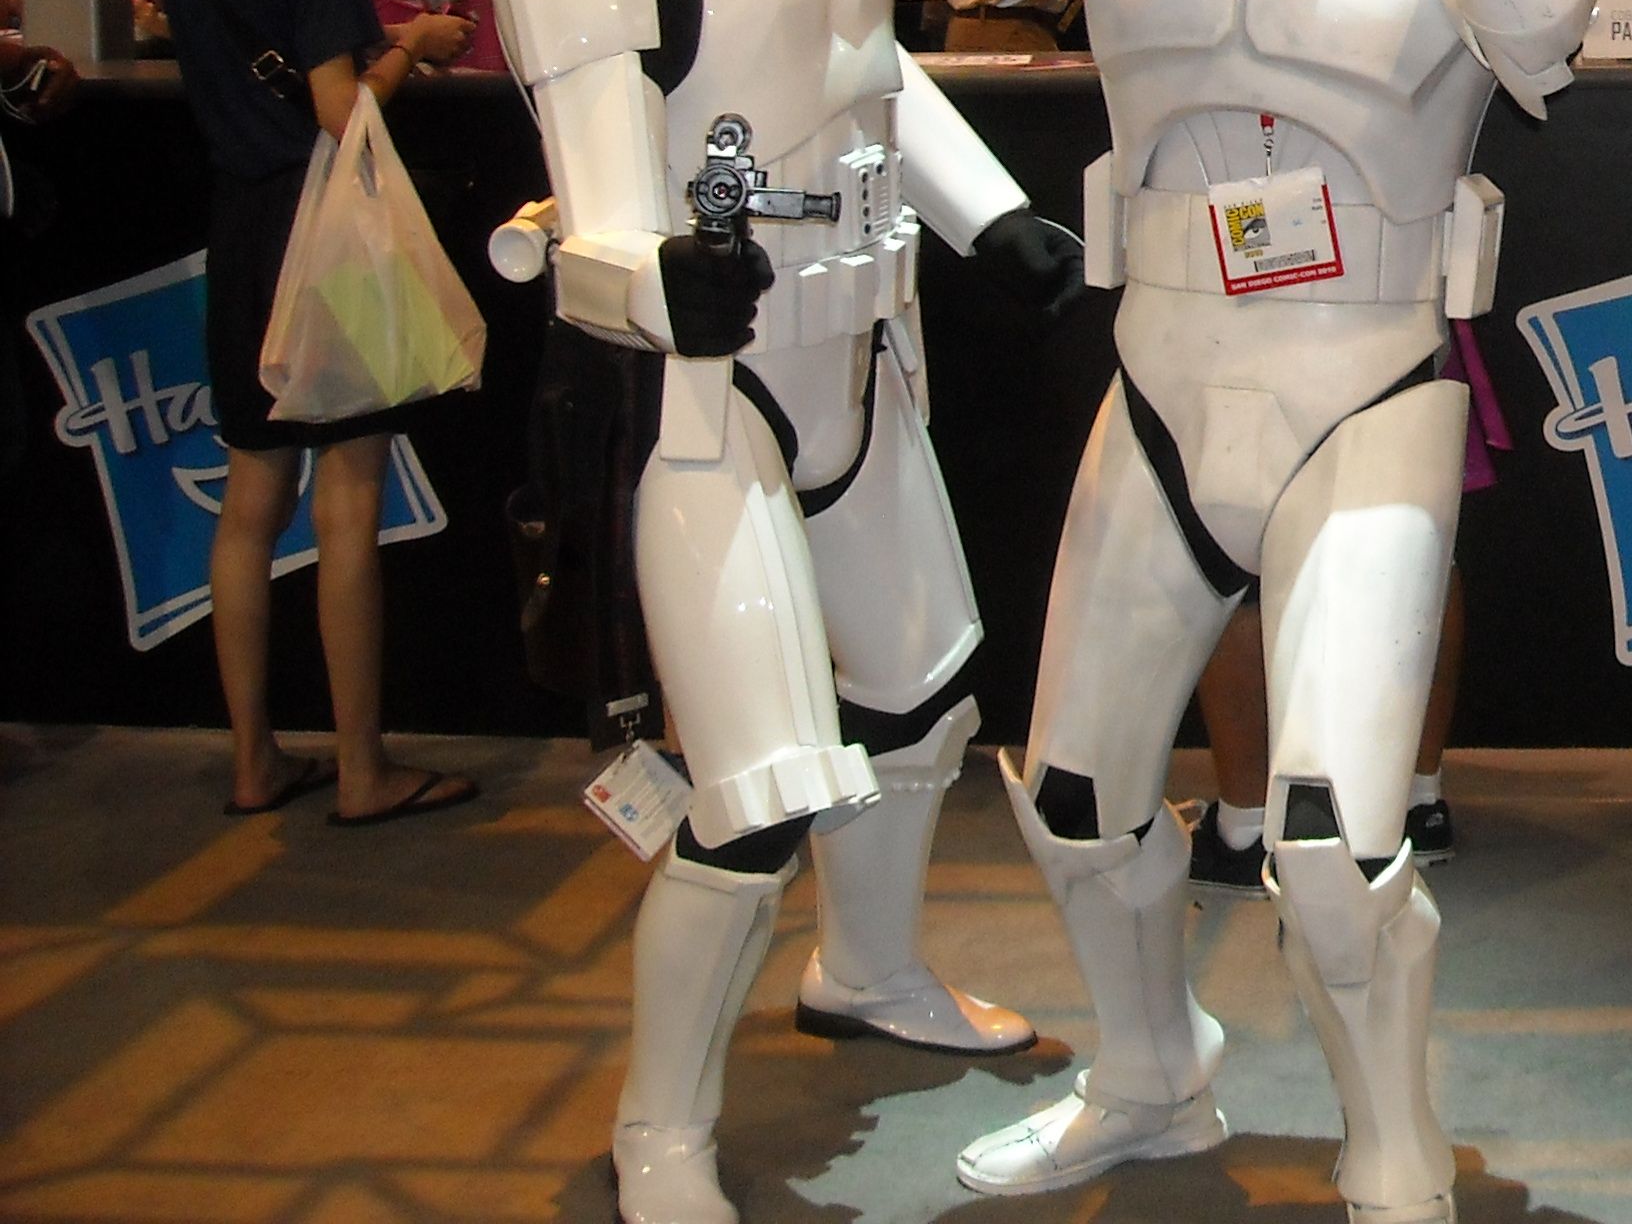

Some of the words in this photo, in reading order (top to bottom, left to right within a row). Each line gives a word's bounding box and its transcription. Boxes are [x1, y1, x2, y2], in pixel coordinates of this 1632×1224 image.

[1239, 202, 1265, 220] CON
[1226, 208, 1246, 247] COMIC
[1230, 281, 1247, 291] SAN
[1247, 276, 1273, 288] DIEGO
